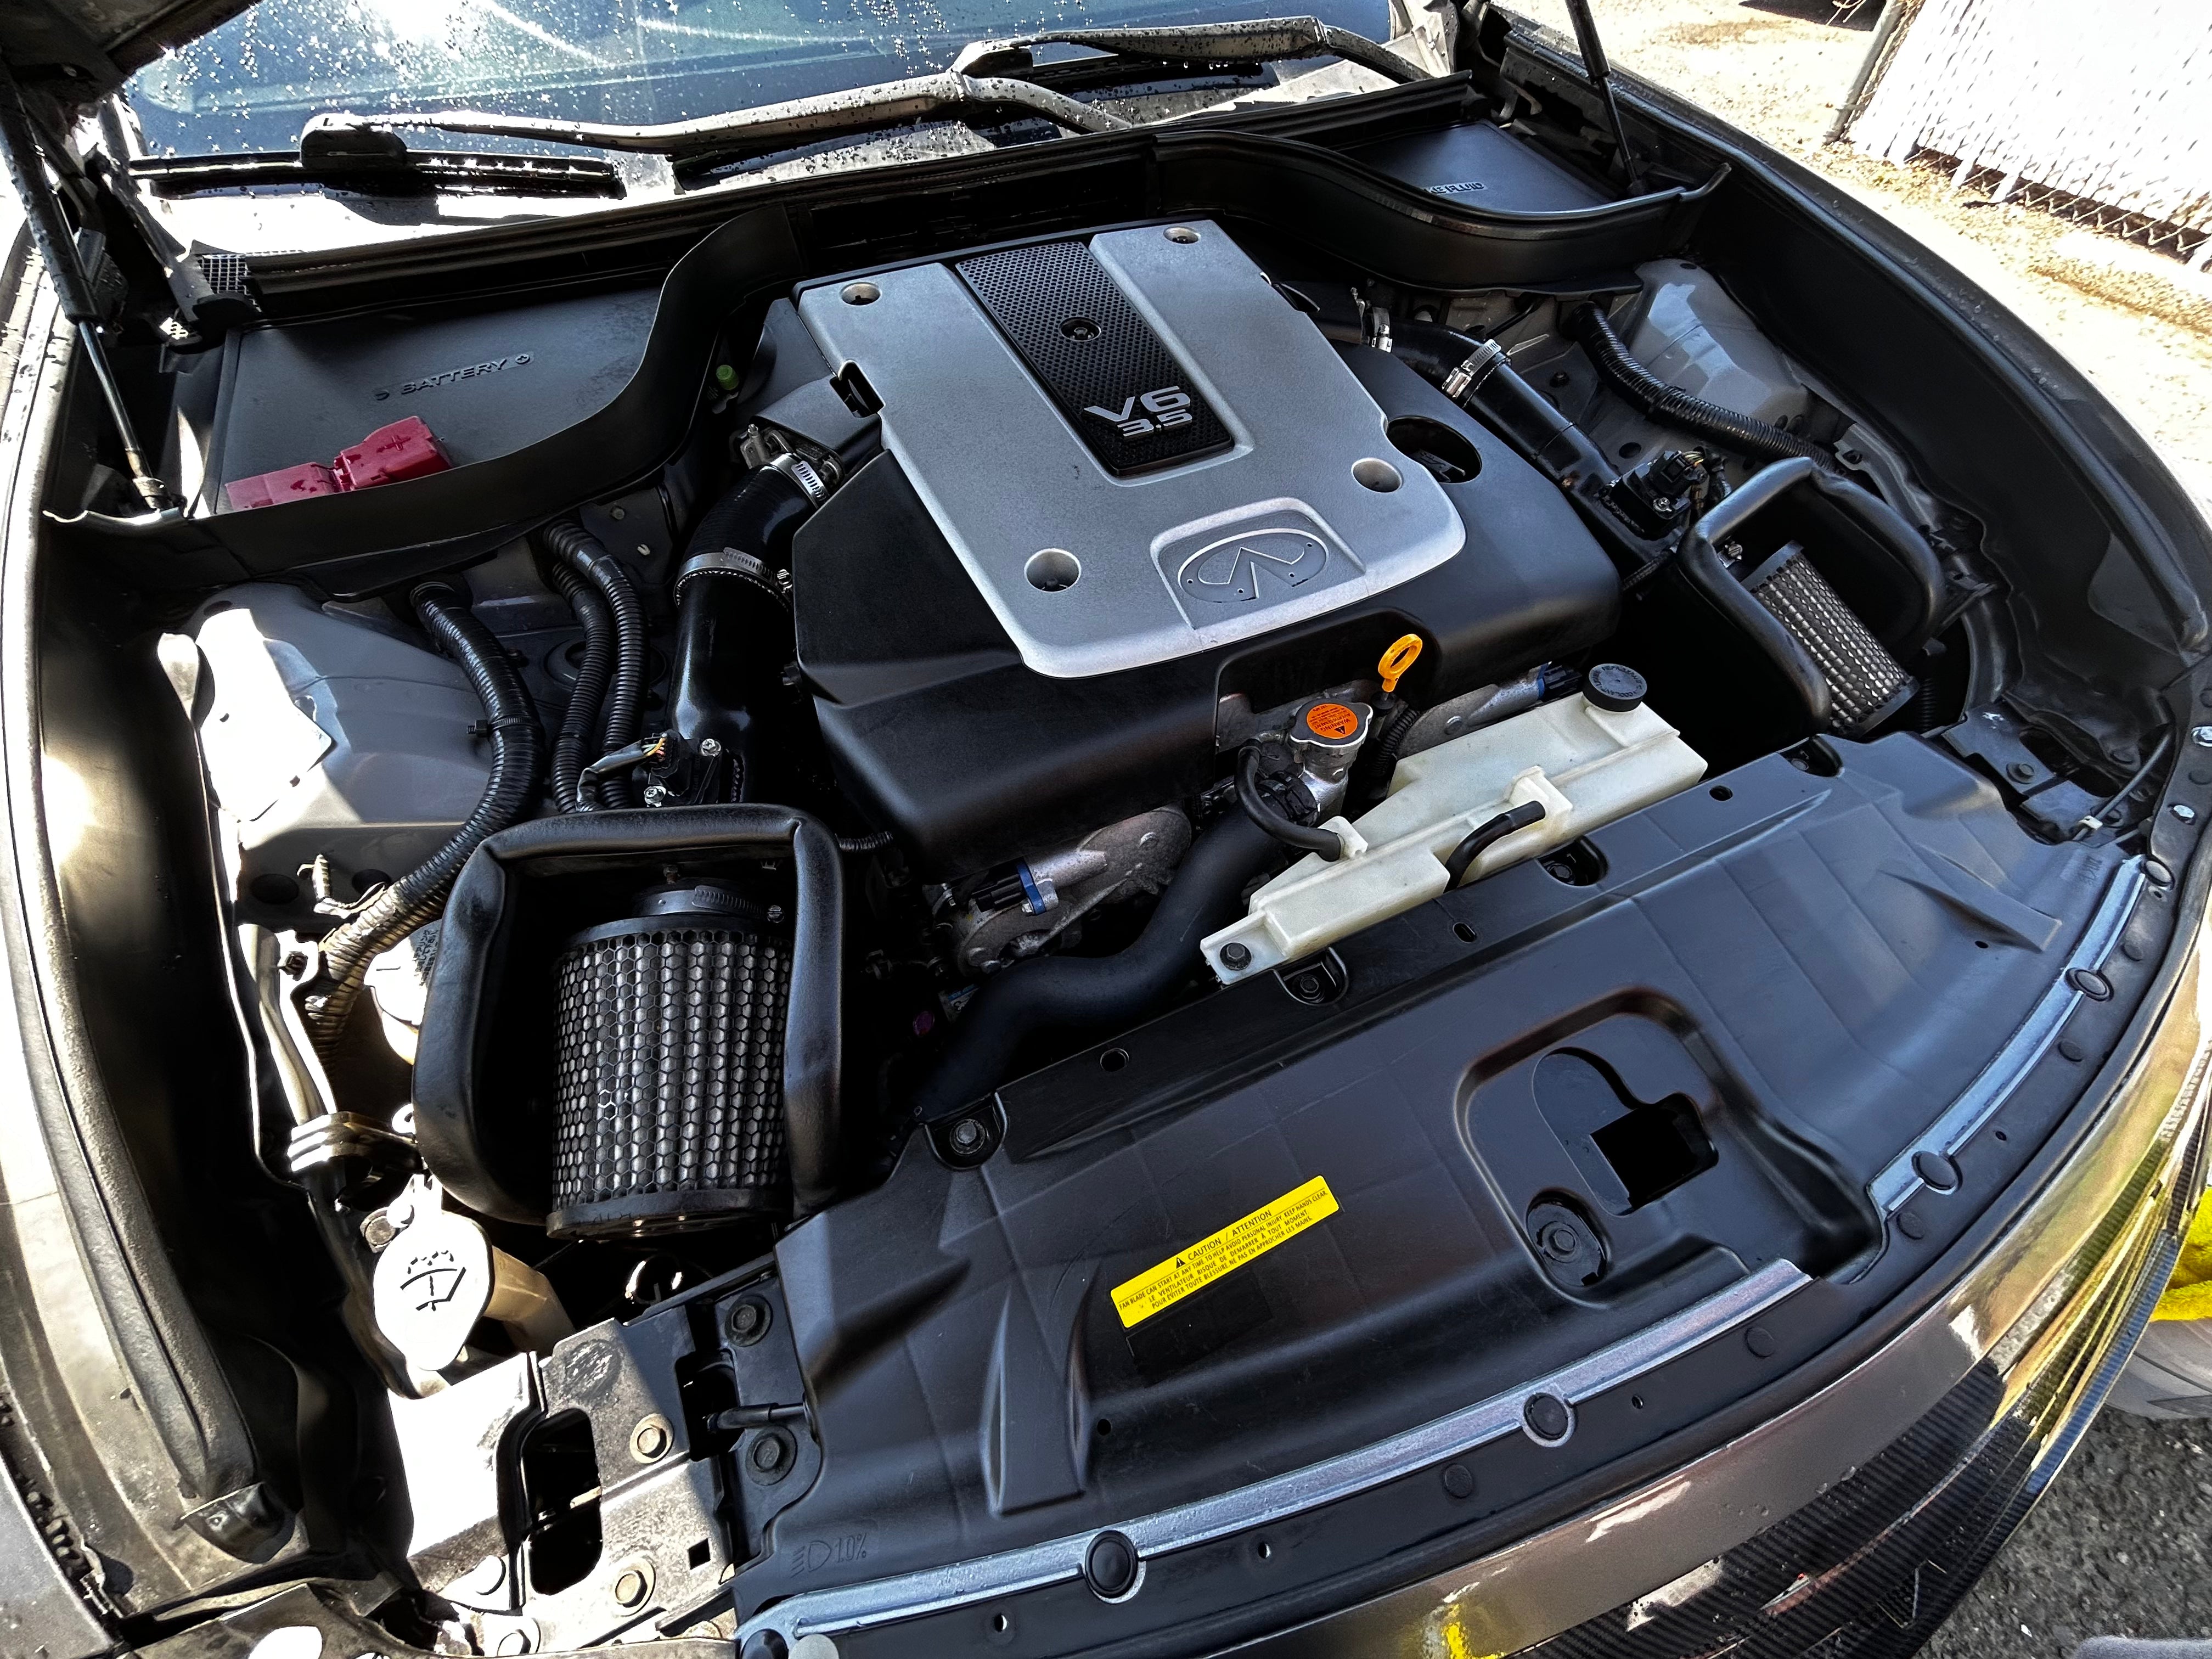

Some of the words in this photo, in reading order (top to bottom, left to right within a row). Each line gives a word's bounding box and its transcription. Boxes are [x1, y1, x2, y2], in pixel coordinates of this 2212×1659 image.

[1445, 182, 1484, 192] FLUID
[401, 358, 507, 395] BATTERY
[1083, 385, 1191, 423] V6
[1117, 408, 1193, 437] 3.5
[1320, 718, 1350, 732] WARNING
[1129, 1291, 1146, 1303] BLADE
[1146, 1285, 1157, 1295] CAN
[1157, 1276, 1172, 1288] START
[1181, 1266, 1191, 1275] ANY
[1212, 1247, 1224, 1257] HELP
[1225, 1239, 1241, 1250] AVOID
[1241, 1225, 1265, 1241] PERSONAL
[1284, 1207, 1294, 1217] KEEP
[1296, 1199, 1312, 1211] HANDS
[1188, 1238, 1221, 1260] CAUTION
[1232, 1210, 1271, 1236] ATTENTION
[1151, 1297, 1167, 1308] POUR
[1185, 1276, 1202, 1289] TOUTE
[1237, 1251, 1247, 1261] PAS
[1257, 1230, 1285, 1250] APPROCHER
[1286, 1225, 1294, 1233] LES
[1158, 1273, 1194, 1296] VENTILATEUR
[1196, 1261, 1216, 1275] RISQUE
[1267, 1224, 1281, 1235] TOUT
